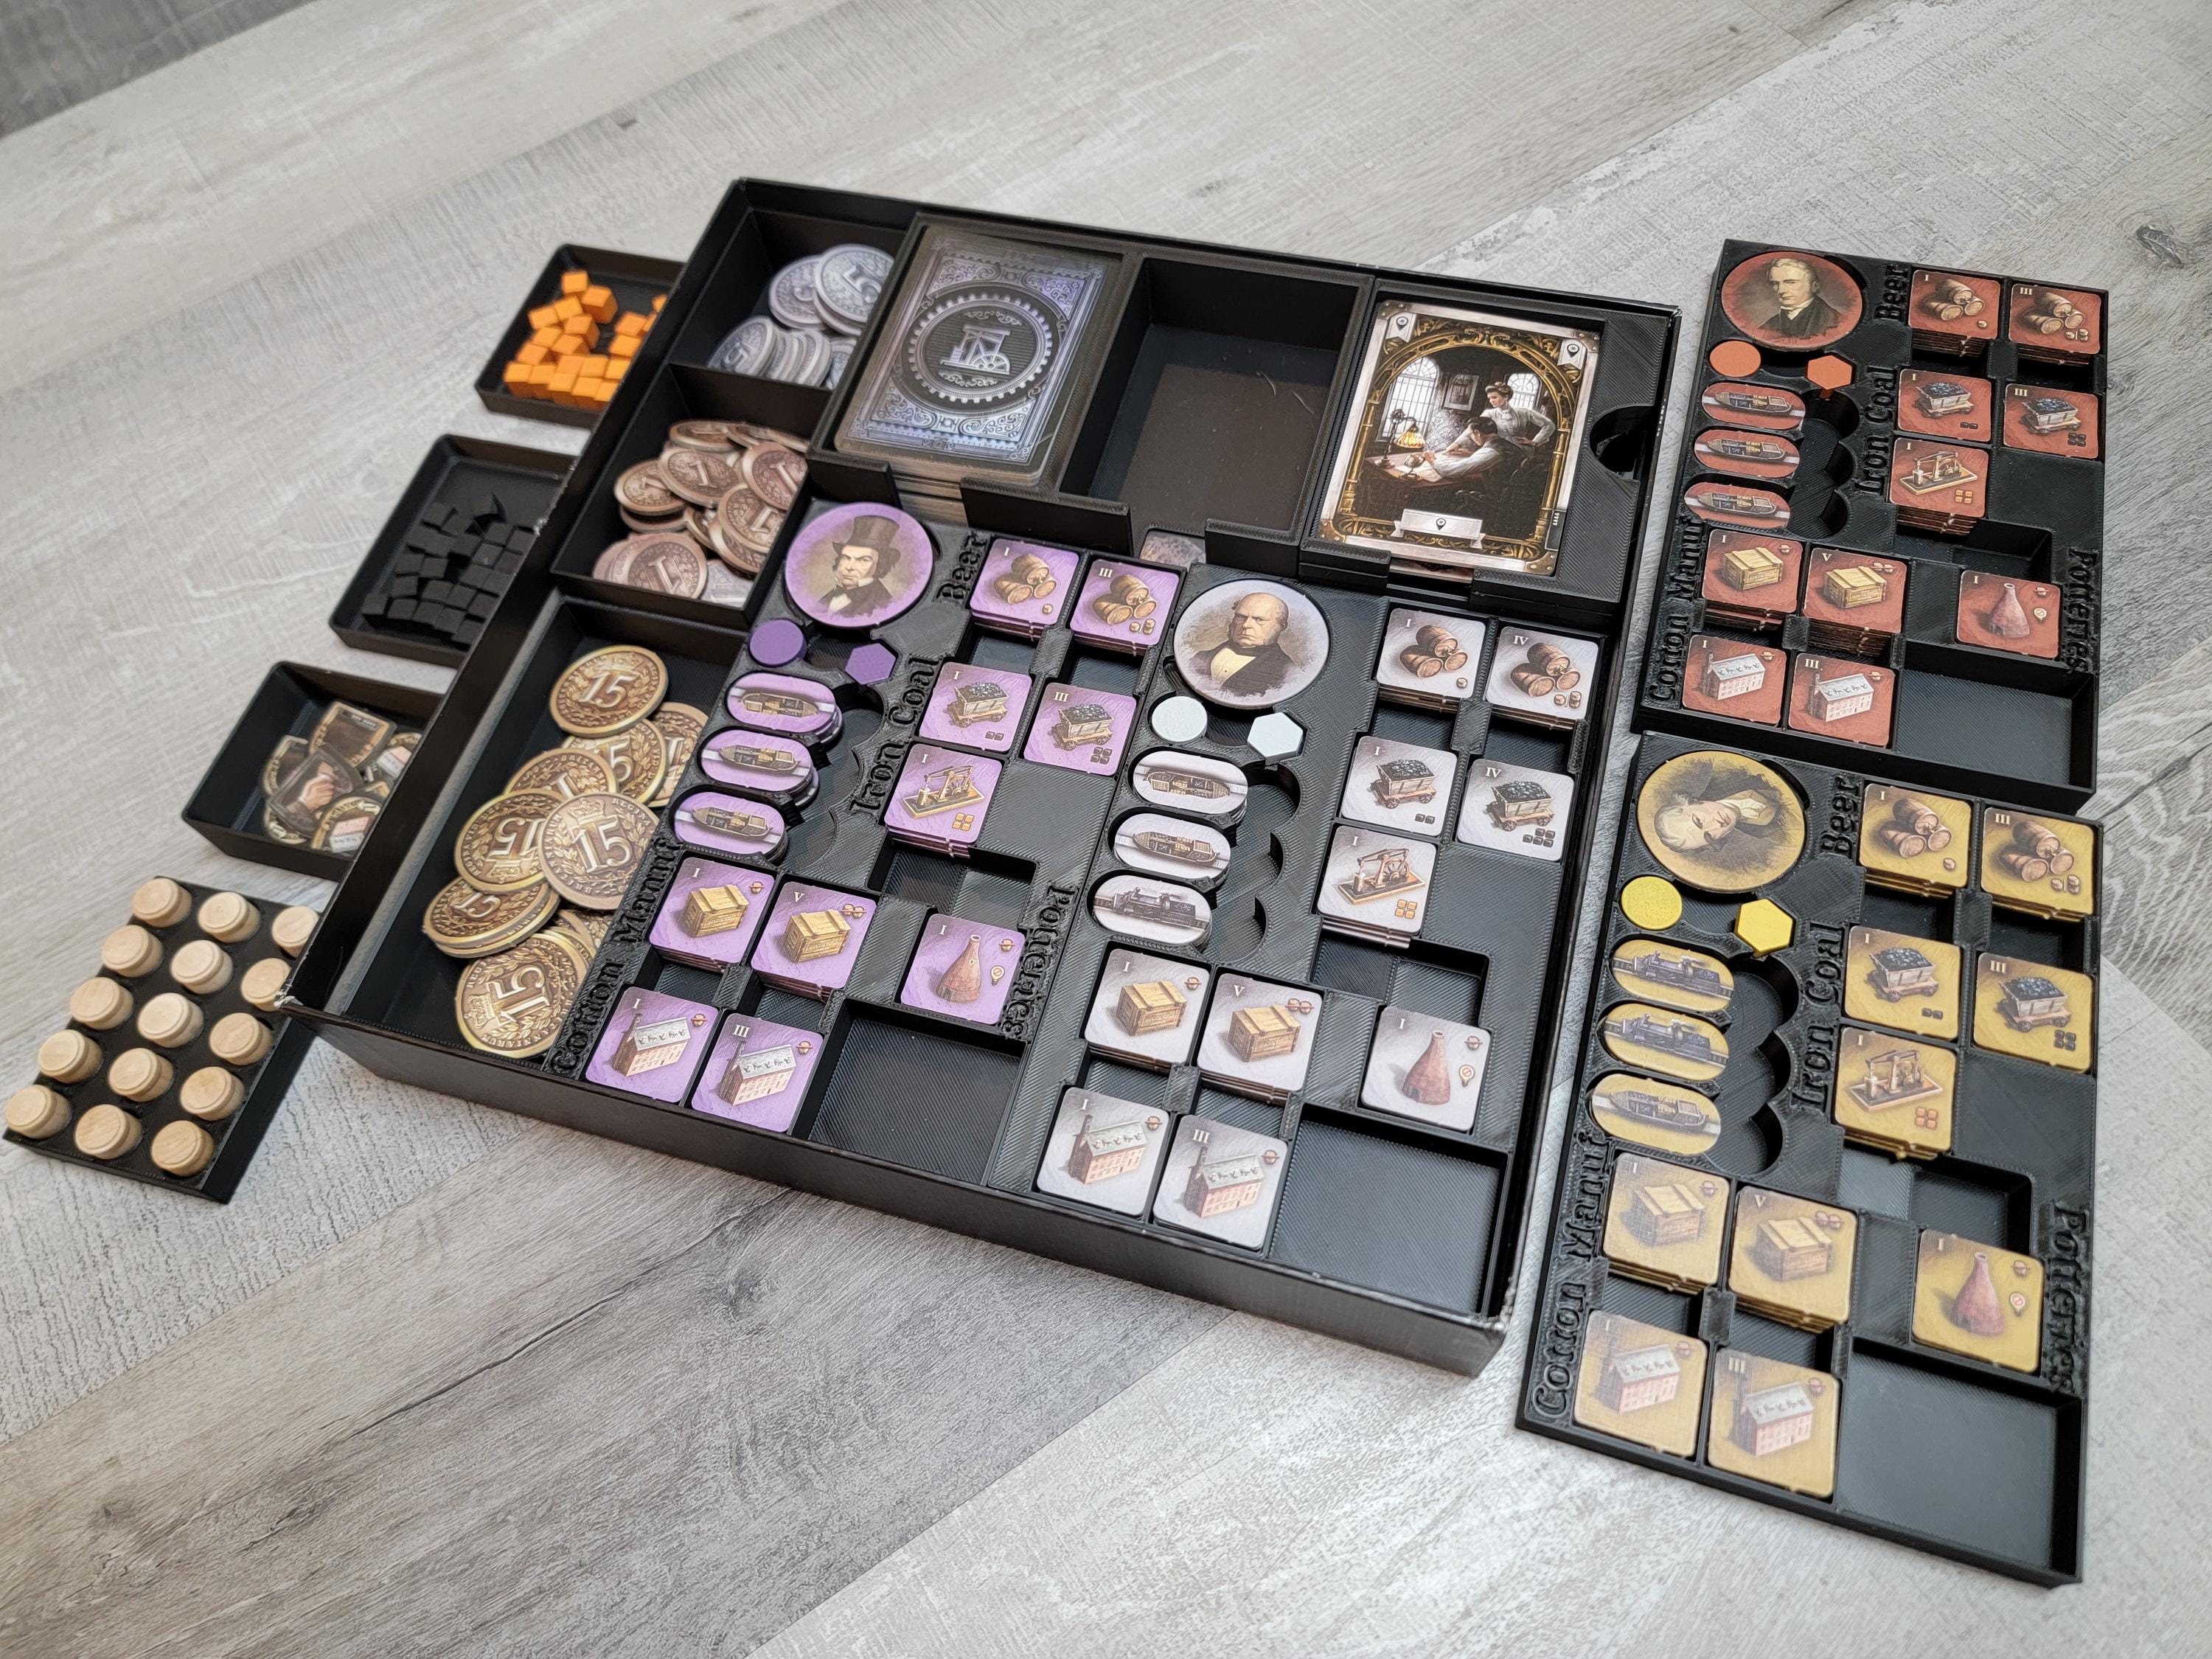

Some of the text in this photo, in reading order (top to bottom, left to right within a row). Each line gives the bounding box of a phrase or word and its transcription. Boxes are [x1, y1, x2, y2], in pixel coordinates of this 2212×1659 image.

[842, 262, 882, 304] 5
[1873, 262, 1908, 321] Beer
[2020, 287, 2033, 296] III
[1863, 365, 1898, 423] Coal
[2014, 388, 2028, 397] III
[688, 460, 717, 488] 1
[1853, 435, 1890, 493] Iron
[748, 505, 779, 532] 1
[935, 532, 987, 602] Beer
[1099, 568, 1113, 578] III
[2067, 547, 2098, 672] Potteries
[1513, 635, 1529, 645] IV
[1648, 614, 1691, 700] Cotton
[1805, 658, 1820, 669] III
[577, 672, 640, 709] 15
[888, 654, 939, 726] Coal
[1053, 691, 1069, 703] III
[608, 734, 634, 783] 5
[849, 740, 906, 814] Iron
[1485, 766, 1502, 778] IV
[611, 797, 651, 827] REGINA
[1820, 775, 1860, 855] Beer
[1995, 813, 2011, 825] III
[485, 816, 547, 860] 15
[569, 815, 633, 874] 15
[1001, 883, 1076, 1040] Potteries
[1804, 921, 1845, 1006] Coal
[1990, 960, 2006, 974] III
[485, 966, 551, 1026] 15
[550, 961, 625, 1072] Cotton
[732, 1024, 751, 1038] III
[1790, 1024, 1834, 1109] Iron
[1192, 1129, 1211, 1144] III
[2051, 1202, 2087, 1394] Potteries
[1532, 1281, 1586, 1418] Cotton
[1728, 1357, 1745, 1374] III
